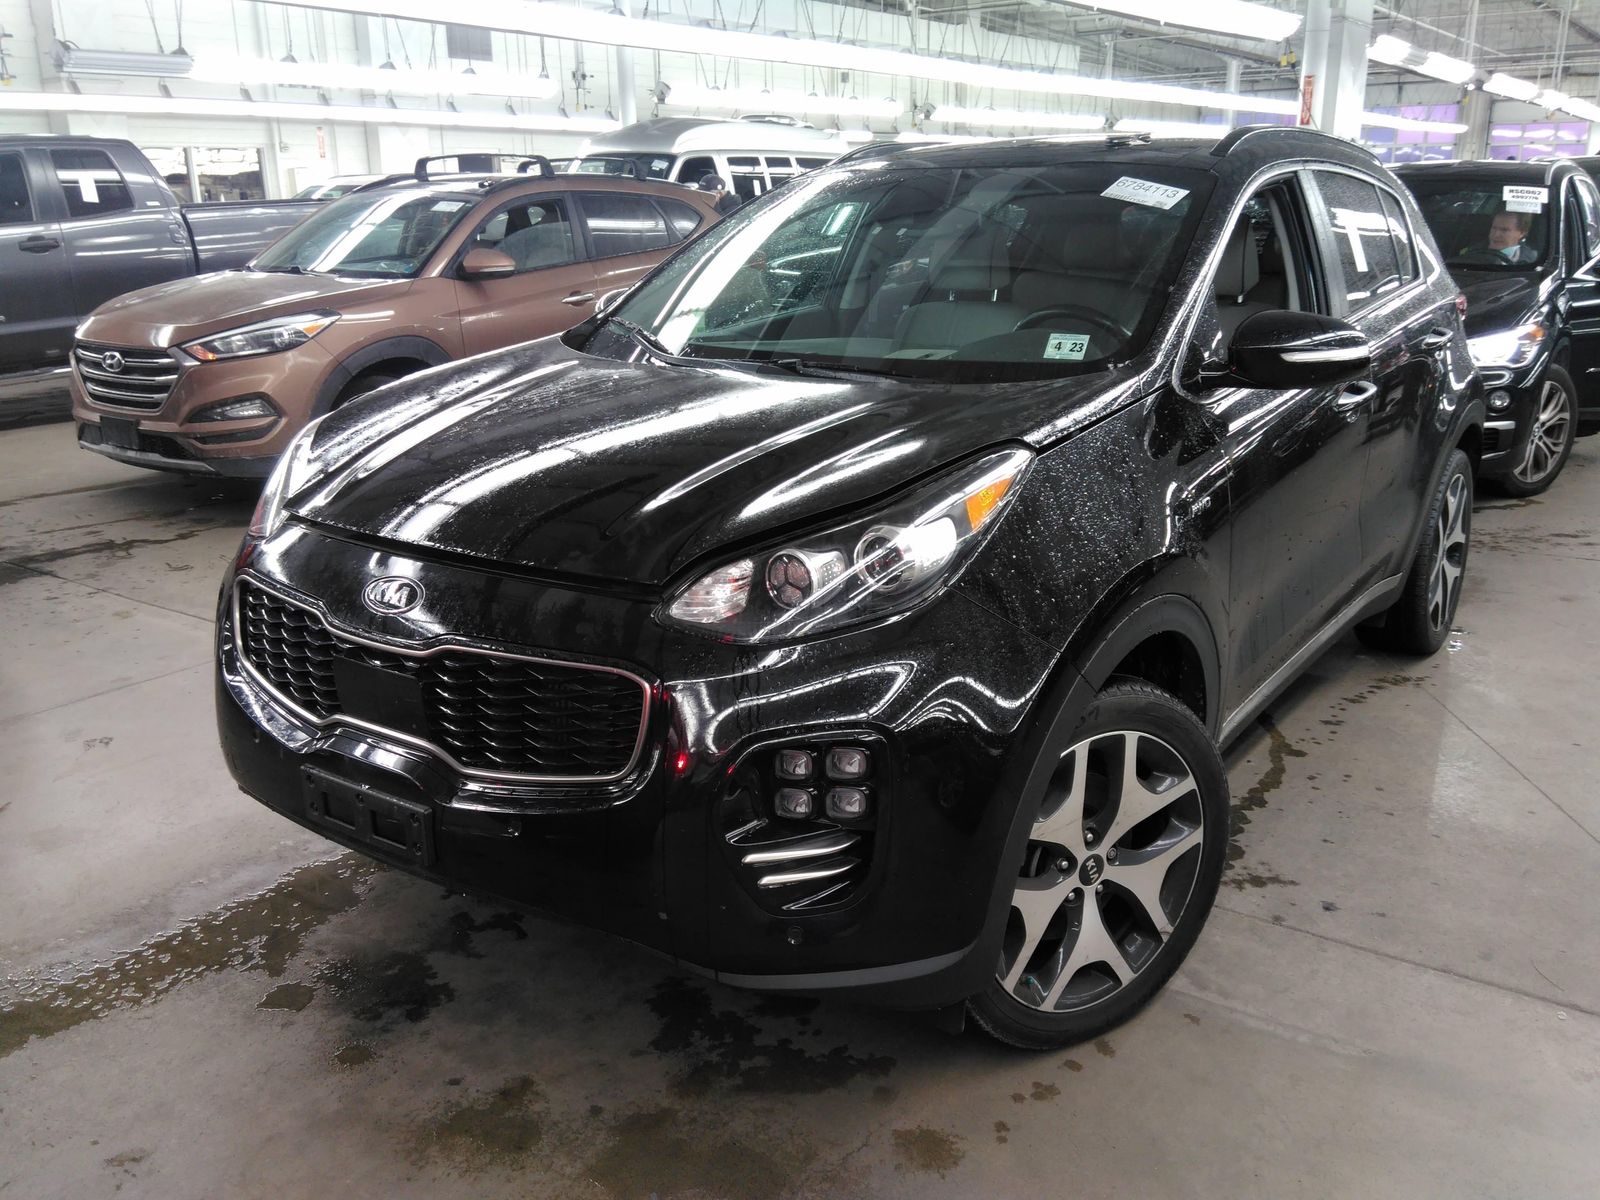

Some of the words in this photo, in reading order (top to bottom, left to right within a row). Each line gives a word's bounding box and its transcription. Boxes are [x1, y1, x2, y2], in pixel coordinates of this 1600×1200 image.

[1115, 179, 1180, 199] 6784113
[1054, 341, 1062, 351] 4
[1069, 342, 1084, 352] 23
[1085, 858, 1099, 883] KIA
